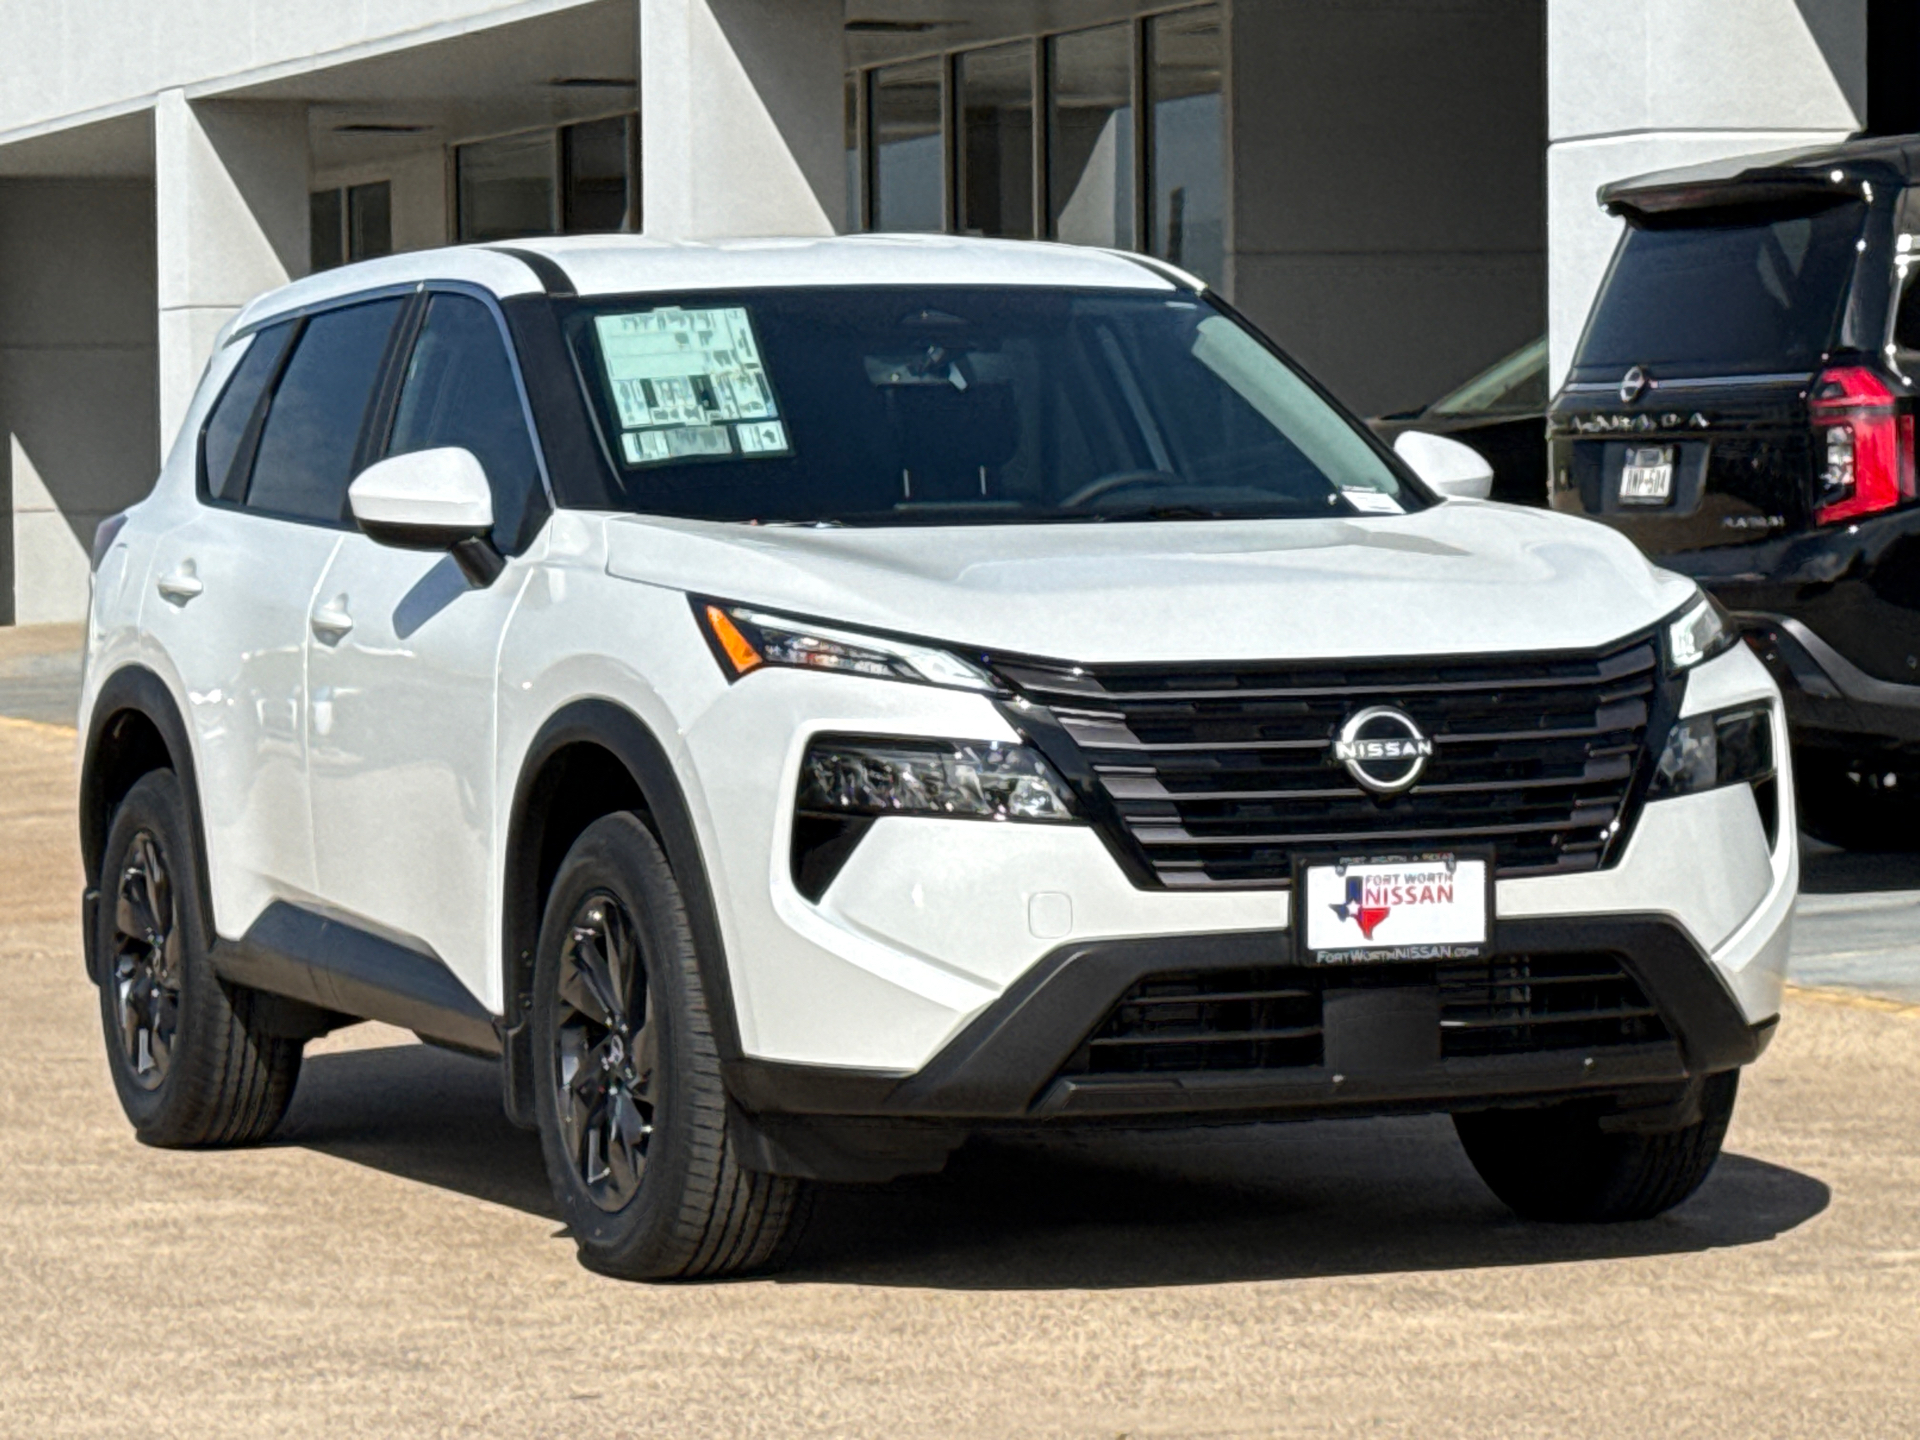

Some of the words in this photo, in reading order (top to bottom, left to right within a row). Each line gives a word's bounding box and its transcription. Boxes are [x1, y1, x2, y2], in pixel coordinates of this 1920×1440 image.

[1335, 740, 1432, 759] NISSAN
[1365, 874, 1401, 886] FORT
[1404, 872, 1454, 885] WORTH
[1365, 884, 1454, 906] NISSAN
